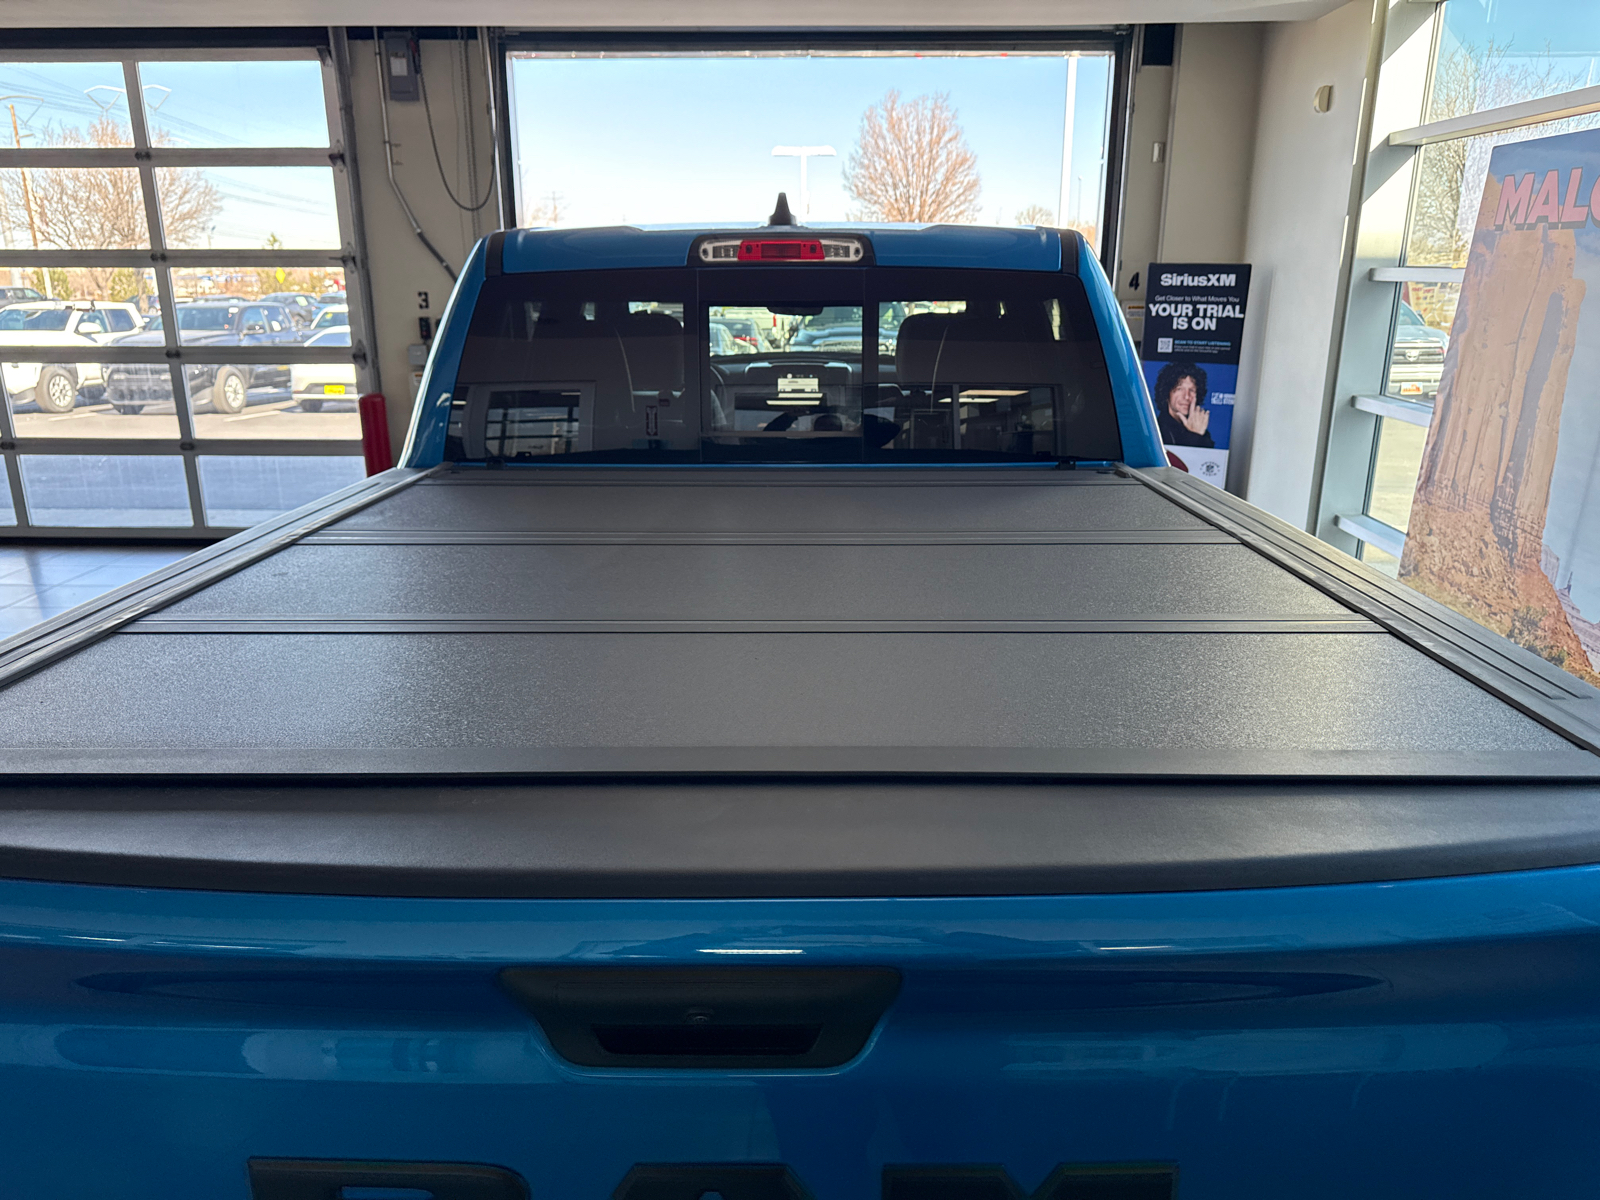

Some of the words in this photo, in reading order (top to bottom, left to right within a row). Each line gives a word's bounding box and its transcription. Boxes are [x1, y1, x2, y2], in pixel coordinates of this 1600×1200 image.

[1129, 272, 1140, 291] 4
[1160, 273, 1236, 287] SiriusXM
[418, 291, 429, 309] 3
[1148, 303, 1193, 317] YOUR
[1196, 304, 1244, 318] TRIAL
[1172, 317, 1189, 330] IS
[1191, 317, 1217, 331] ON
